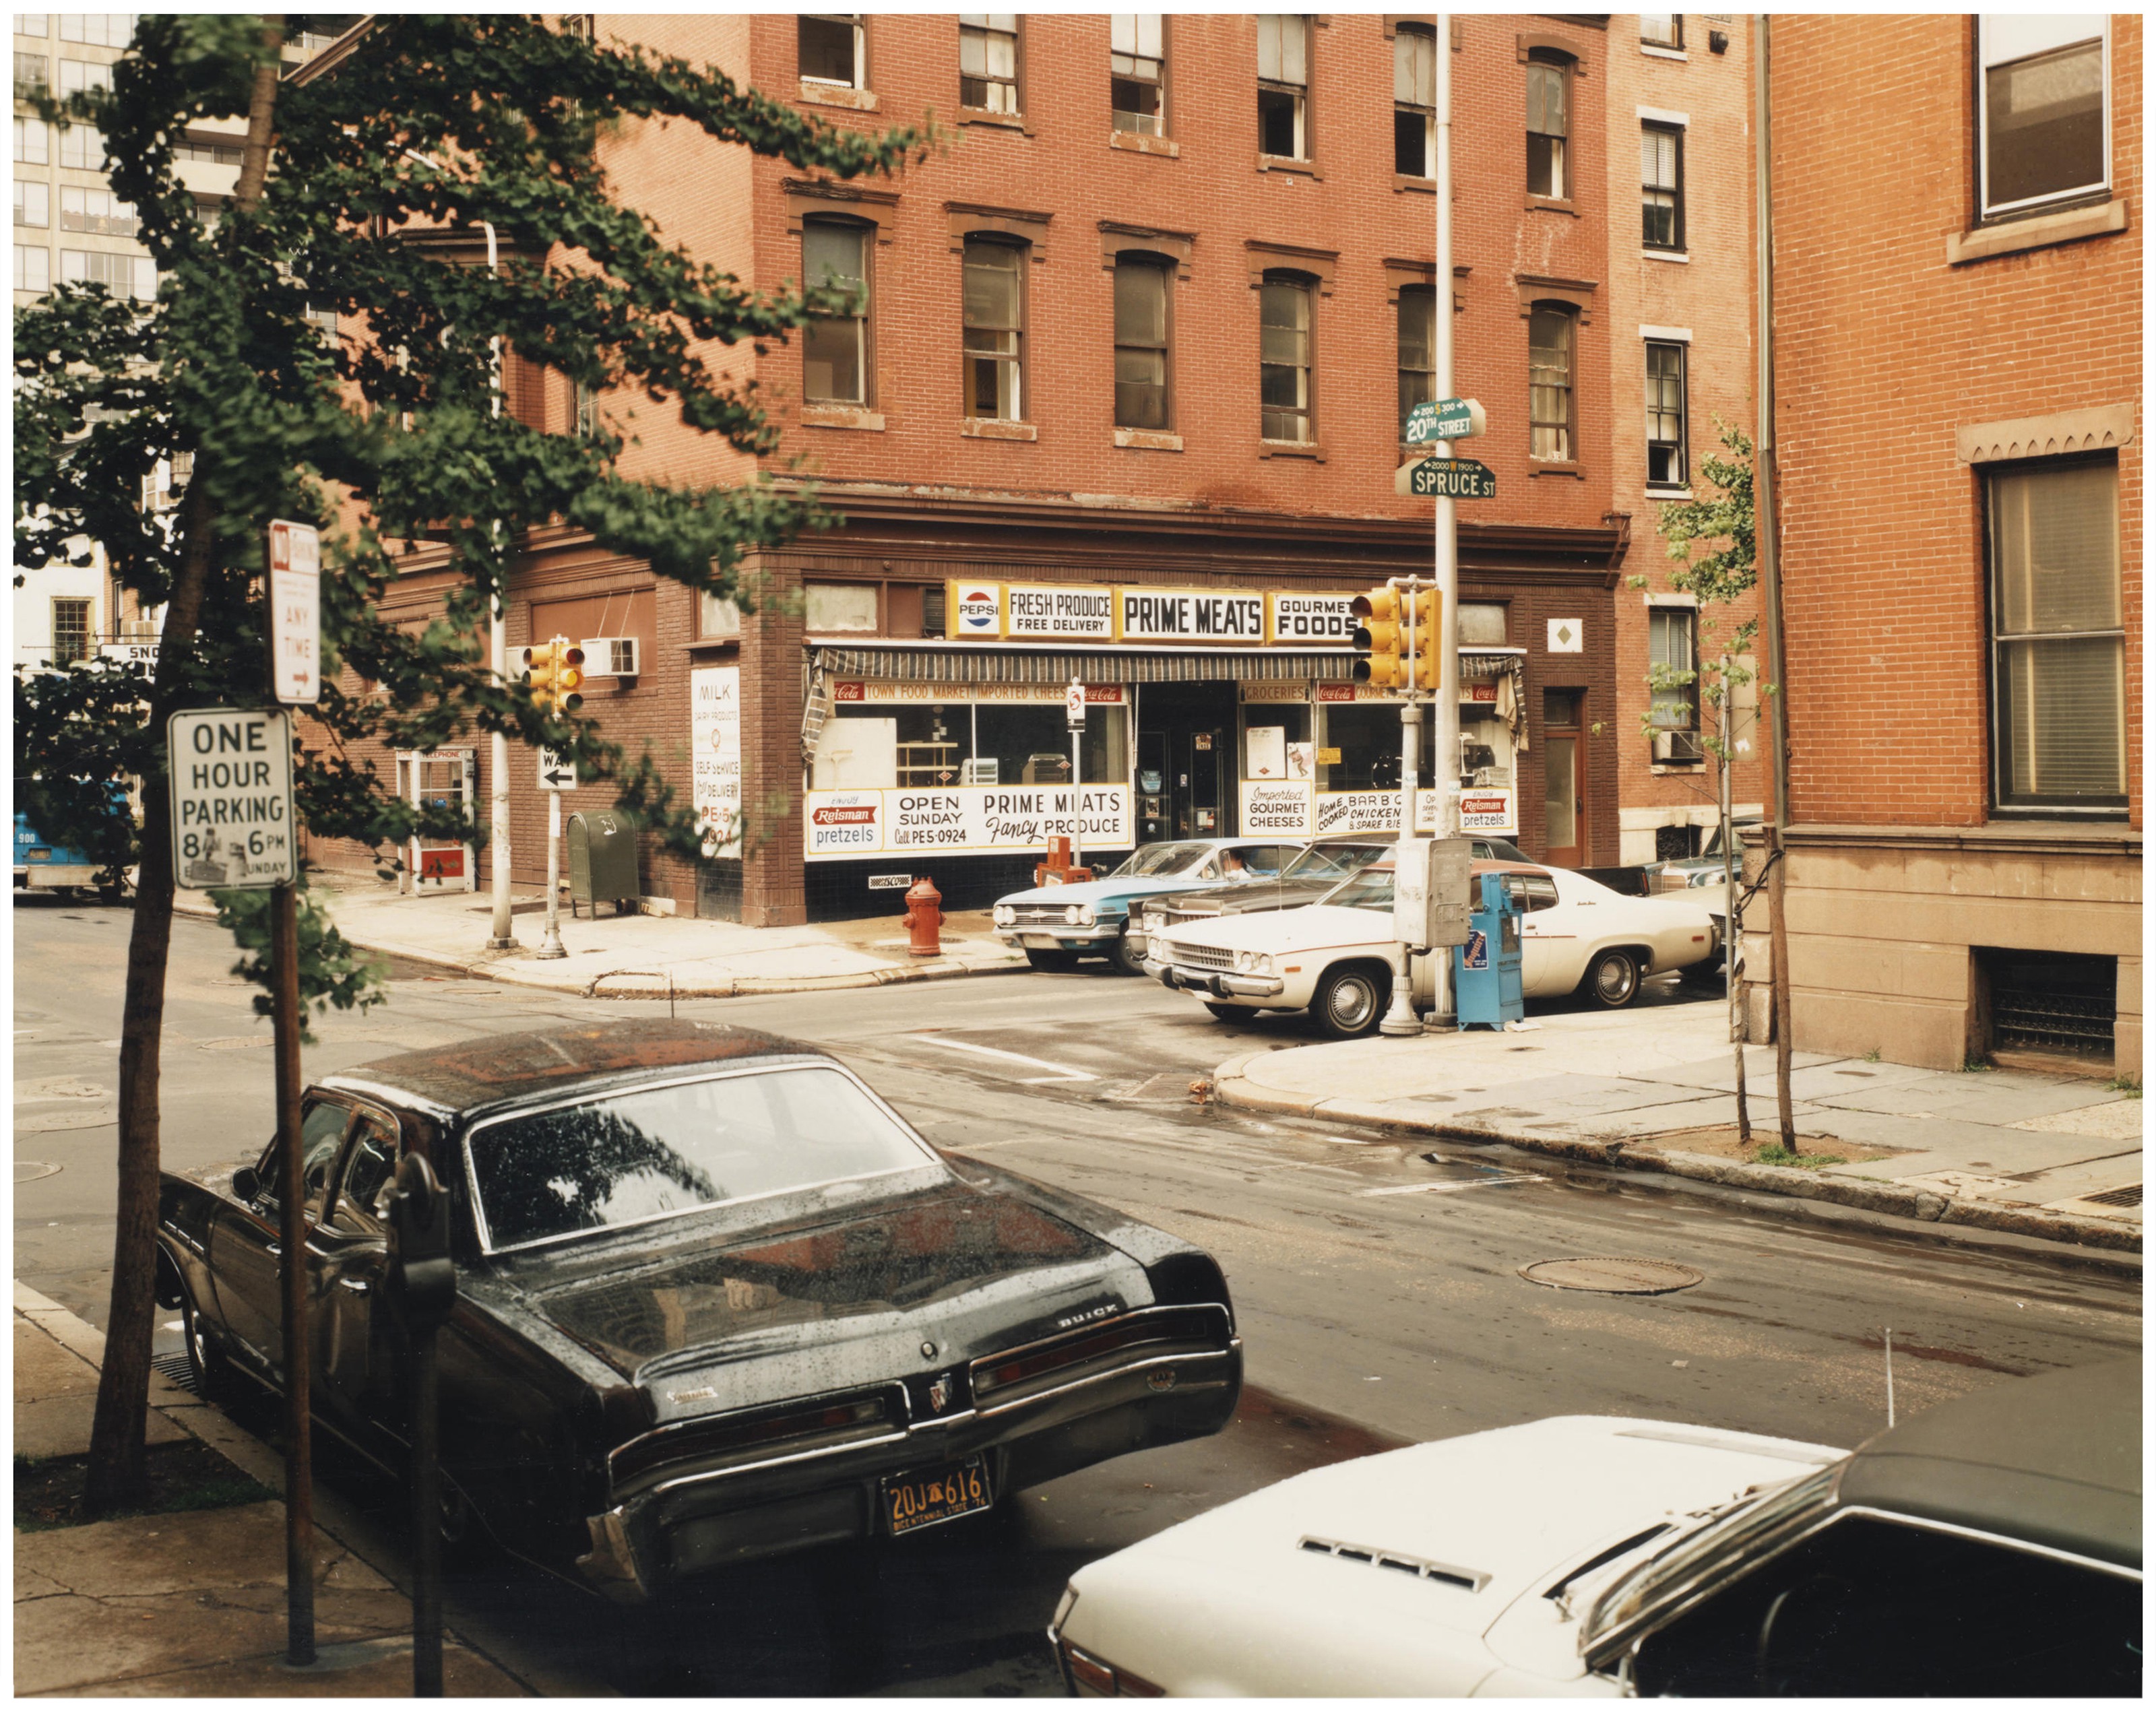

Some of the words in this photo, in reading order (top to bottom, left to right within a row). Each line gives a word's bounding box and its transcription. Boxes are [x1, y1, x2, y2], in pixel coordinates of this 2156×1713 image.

[1421, 407, 1434, 416] 200
[1435, 403, 1441, 415] S
[1442, 403, 1455, 412] 300
[1407, 418, 1436, 442] 20TH
[1438, 418, 1471, 437] STREET
[1431, 461, 1449, 470] 2000
[1450, 461, 1457, 471] W
[1458, 463, 1474, 472] 1900
[1416, 472, 1480, 495] SPRUCE
[1483, 482, 1494, 496] ST
[959, 605, 998, 616] PEPSI
[1010, 593, 1053, 616] FRESH
[1057, 595, 1110, 617] PRODUCE
[1281, 600, 1354, 614] GOURMET
[286, 606, 309, 627] ANY
[1124, 597, 1189, 633] PRIME
[1195, 598, 1261, 635] MEATS
[1017, 618, 1048, 630] FREE
[1053, 619, 1104, 632] DELIVERY
[1279, 616, 1359, 635] FOODS
[285, 637, 310, 659] TIME
[699, 684, 732, 700] MILK
[866, 684, 895, 699] TOWN
[901, 684, 928, 699] FOOD
[933, 684, 971, 699] MARKET
[977, 685, 1028, 699] IMPORTED
[1034, 686, 1067, 700] CHEES
[1246, 686, 1304, 699] GROCERIES
[193, 721, 267, 754] ONE
[192, 761, 271, 789] HOUR
[696, 761, 710, 774] SELF
[712, 761, 739, 774] SERVICE
[707, 783, 738, 799] DELIVERY
[1250, 787, 1304, 802] Imported
[183, 796, 284, 826] PARKING
[899, 796, 959, 810] OPEN
[984, 794, 1044, 814] PRIME
[1250, 803, 1306, 814] GOURMET
[1318, 797, 1343, 819] HOME
[1464, 800, 1501, 812] Reisman
[816, 808, 869, 824] Reisman
[899, 812, 963, 826] SUNDAY
[1319, 806, 1348, 831] COOKED
[1350, 808, 1401, 819] CHICKEN
[1464, 814, 1504, 827] pretzels
[986, 816, 1044, 844] Fancy
[1044, 818, 1120, 834] PRODUCE
[1250, 817, 1304, 827] CHEESES
[1349, 821, 1354, 830] &
[1356, 820, 1382, 830] SPARE
[19, 833, 36, 843] 900
[817, 825, 874, 847] pretzels
[895, 829, 910, 844] Call
[183, 833, 201, 858] 8
[248, 831, 264, 855] 6
[267, 835, 285, 850] PM
[246, 862, 288, 875] UNDAY
[1057, 1304, 1118, 1328] BUICK
[890, 1483, 927, 1520] 20J
[946, 1468, 982, 1504] 616
[947, 1502, 968, 1515] STATE
